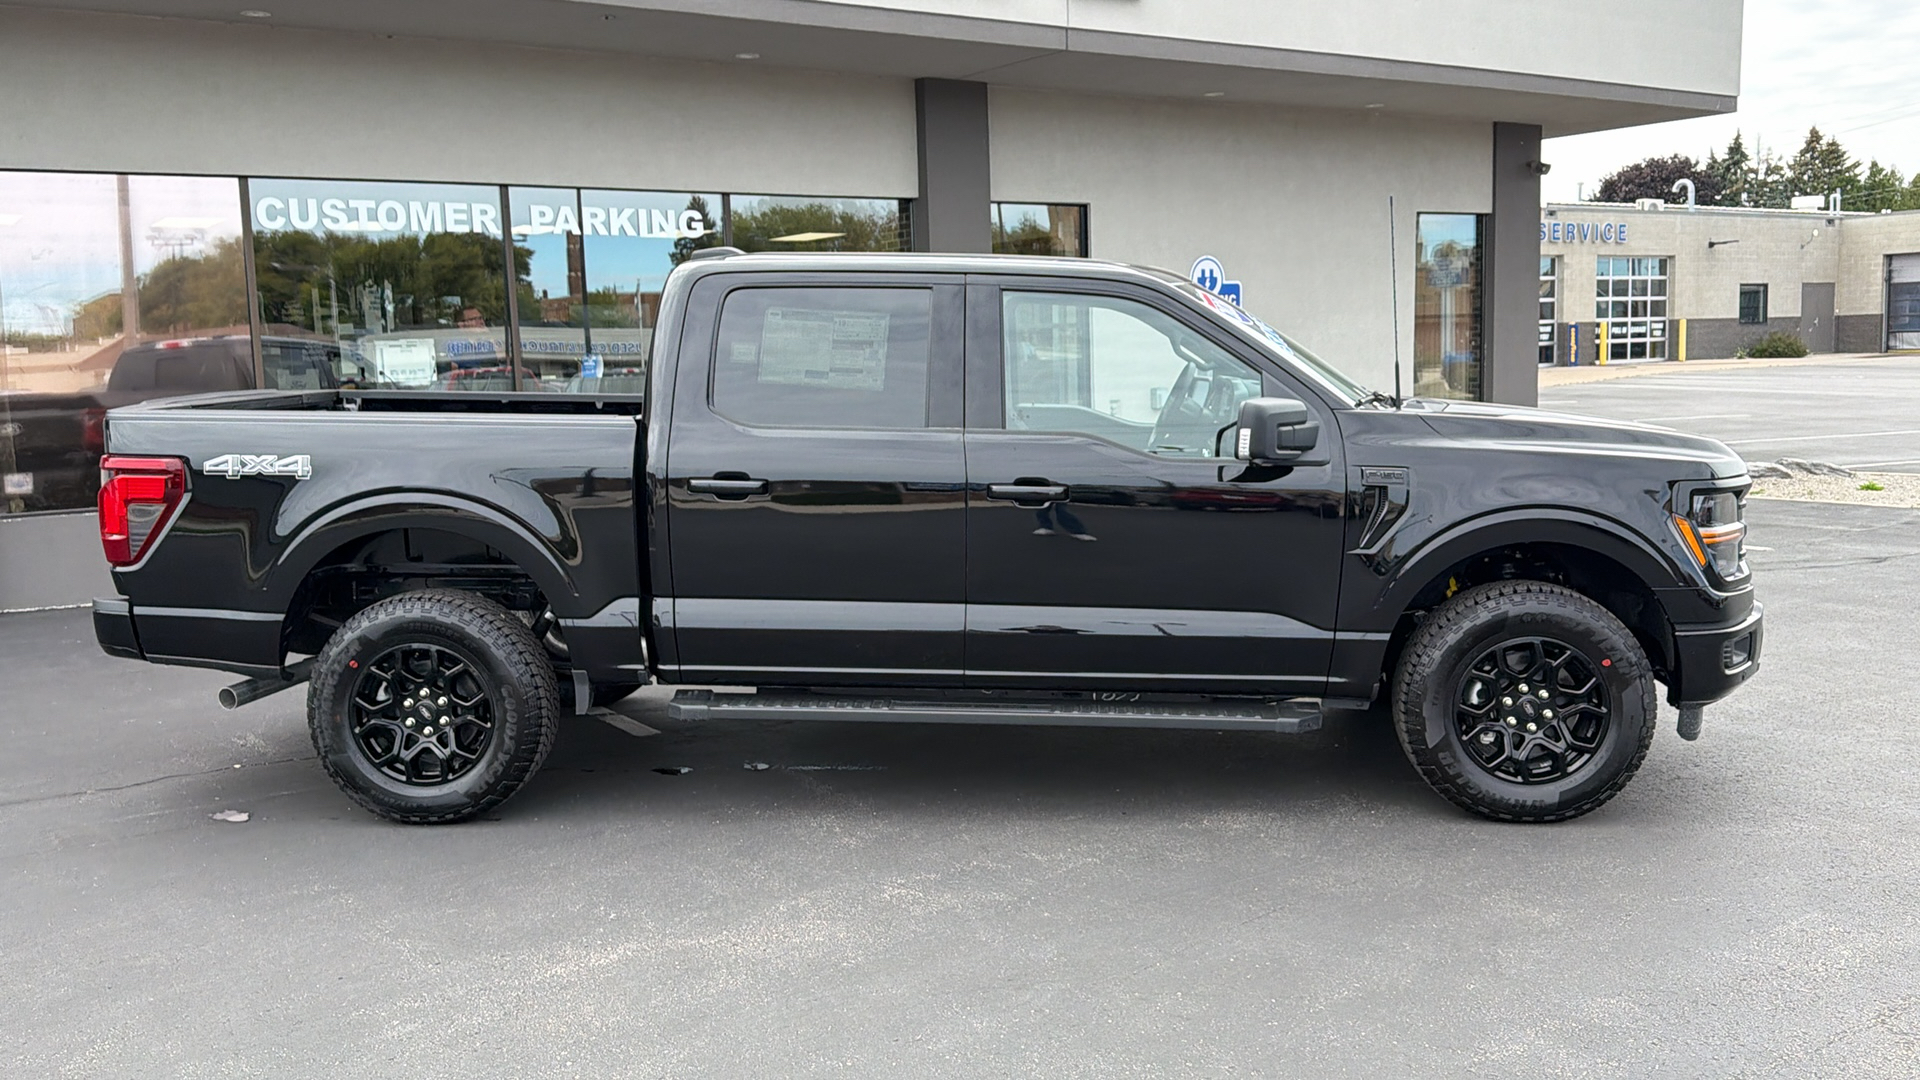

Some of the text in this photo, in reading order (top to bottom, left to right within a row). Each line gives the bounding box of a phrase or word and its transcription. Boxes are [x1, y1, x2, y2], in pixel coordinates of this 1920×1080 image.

[256, 197, 705, 239] CUSTOMER PARKING
[1540, 222, 1628, 243] SERVICE
